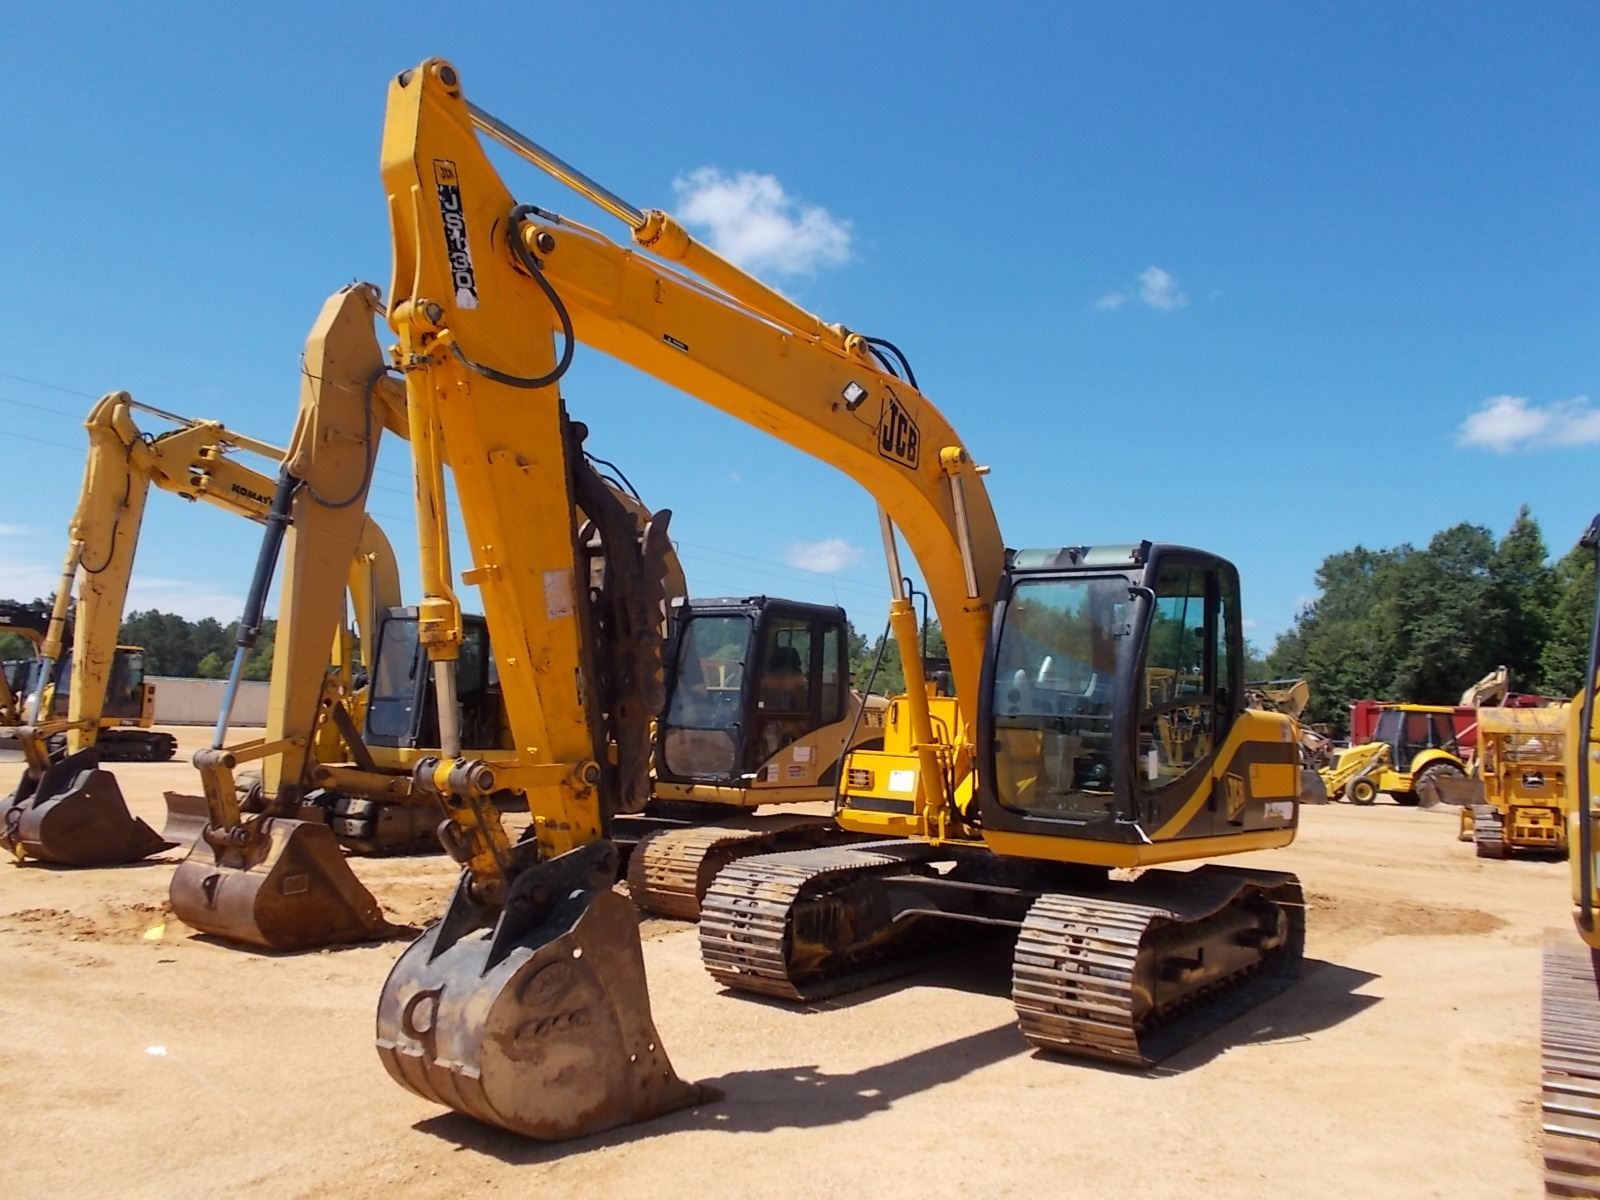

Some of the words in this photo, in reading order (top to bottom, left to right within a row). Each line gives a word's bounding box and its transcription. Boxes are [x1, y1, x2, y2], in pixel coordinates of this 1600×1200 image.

[442, 192, 473, 289] JS130
[882, 399, 917, 462] JCB
[231, 483, 274, 507] KOMAT
